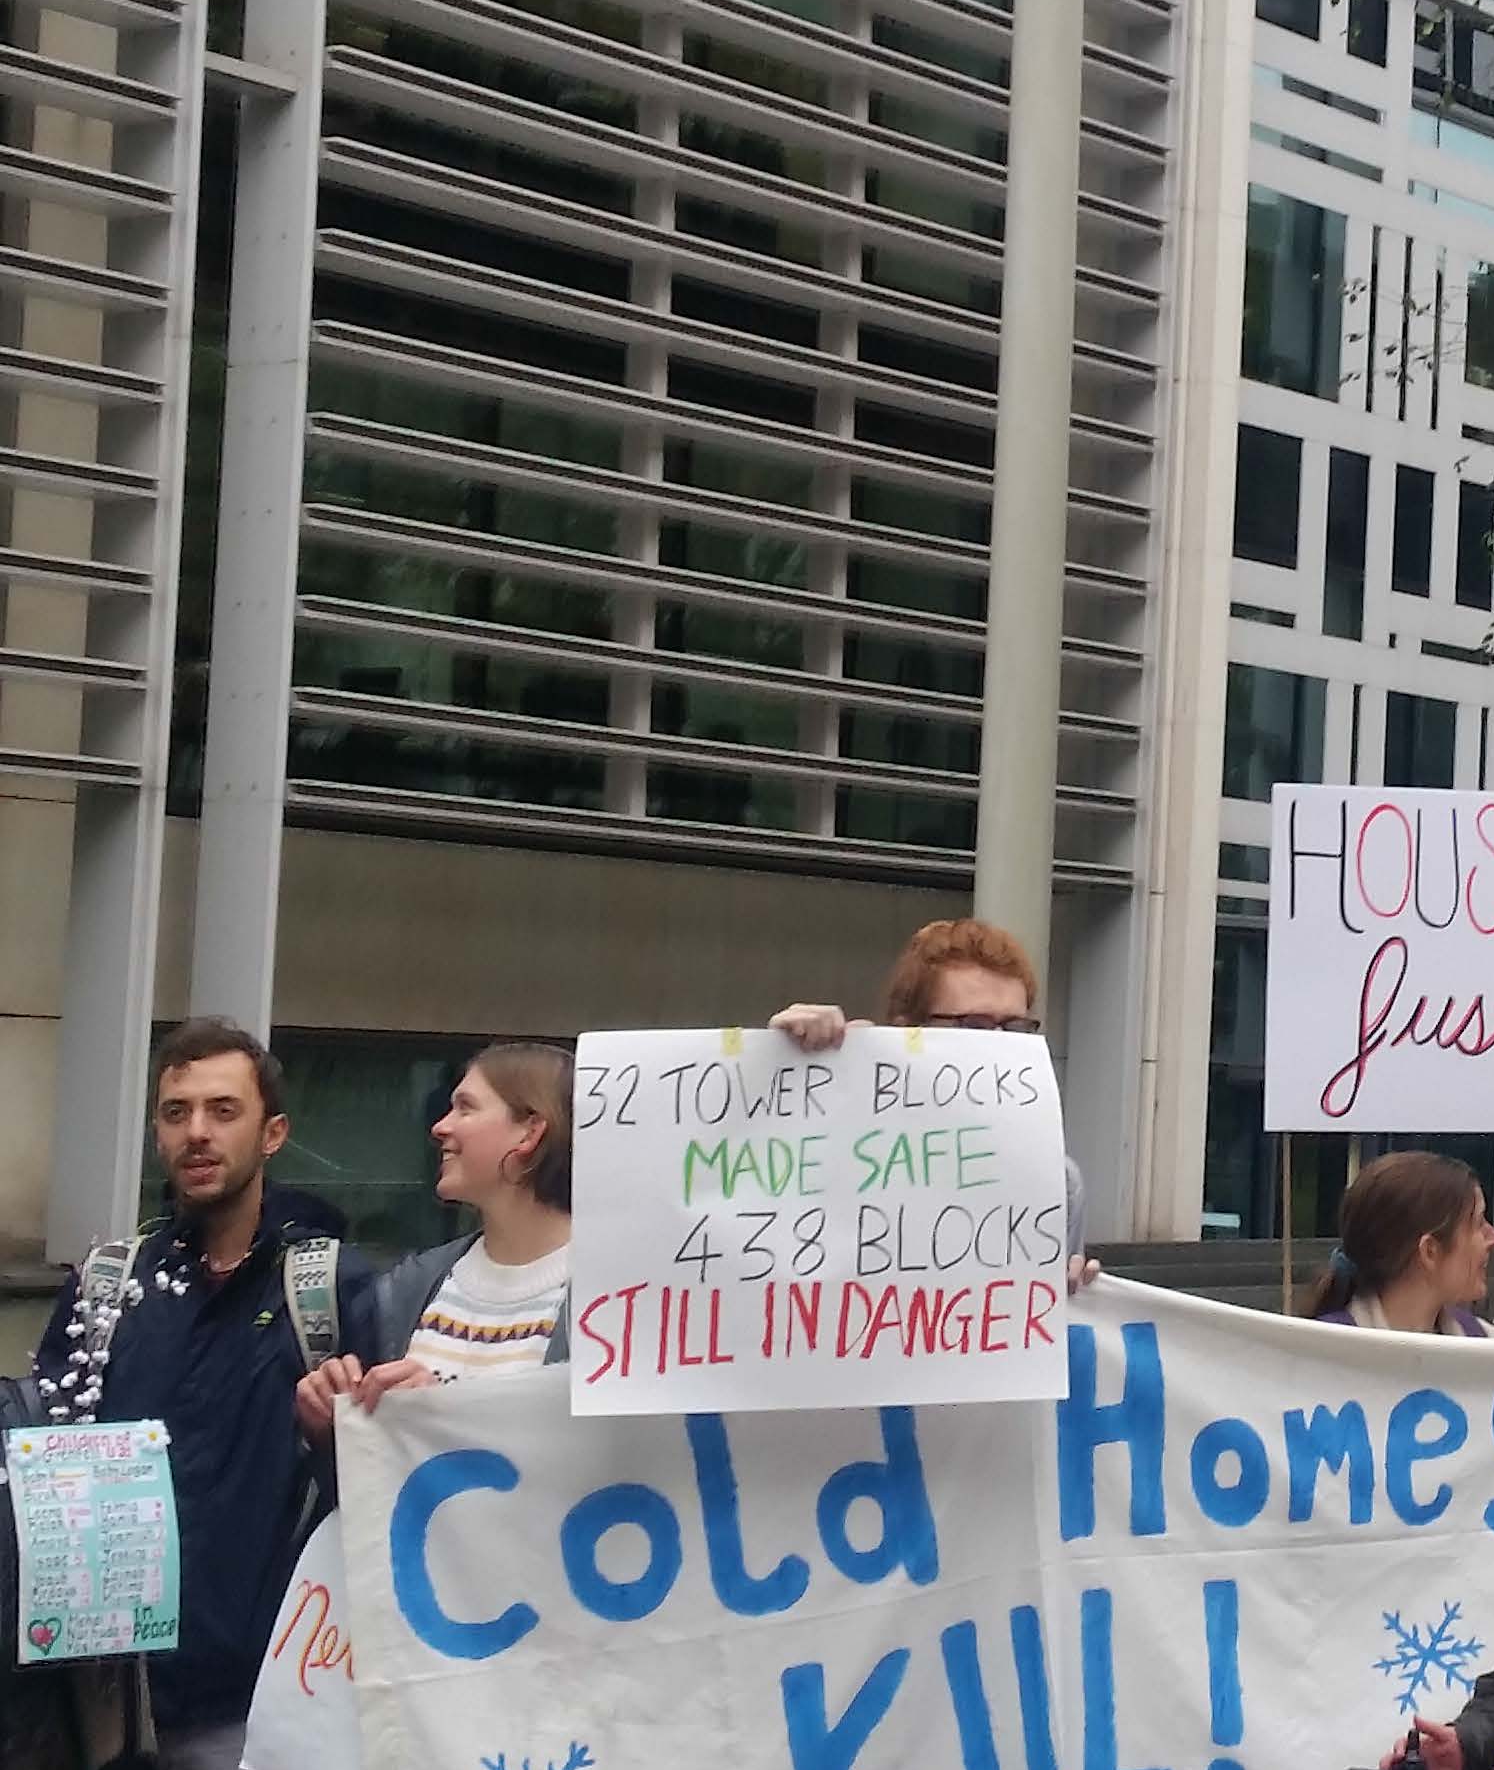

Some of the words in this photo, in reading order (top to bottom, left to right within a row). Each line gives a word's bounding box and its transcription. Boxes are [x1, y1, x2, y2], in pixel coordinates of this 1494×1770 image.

[578, 1065, 640, 1128] 32
[659, 1062, 832, 1126] TOWER
[874, 1062, 1038, 1114] BLOCKS
[684, 1135, 829, 1205] MADE
[853, 1126, 1001, 1192] SAFE
[674, 1206, 826, 1283] 438
[856, 1205, 1062, 1277] BLOCKS
[579, 1282, 734, 1384] STILL
[762, 1282, 822, 1358] IN
[835, 1280, 1058, 1359] DANGER
